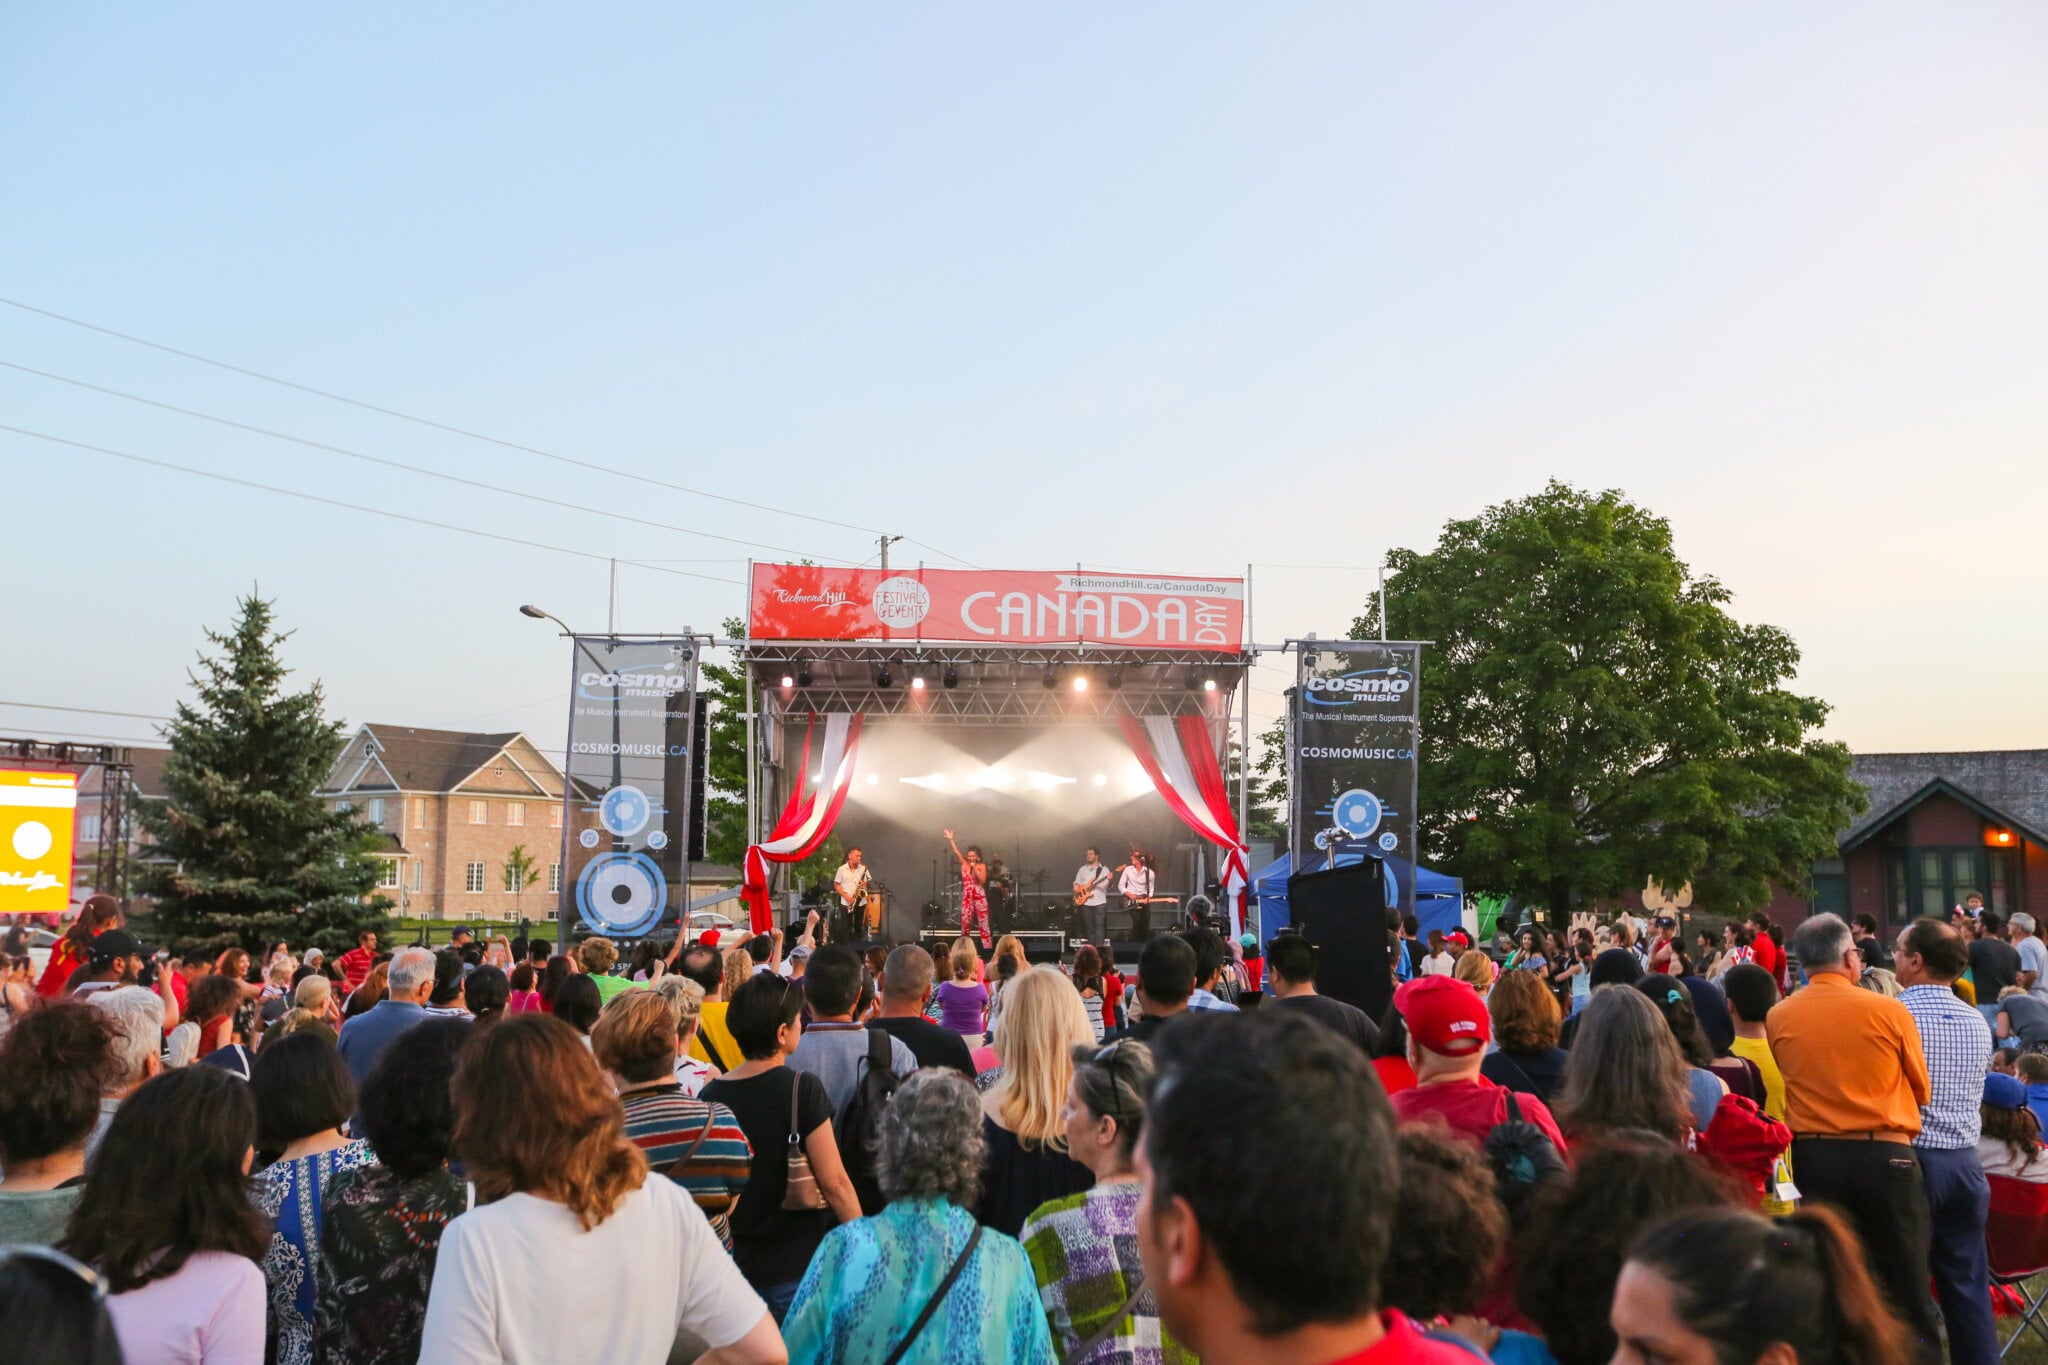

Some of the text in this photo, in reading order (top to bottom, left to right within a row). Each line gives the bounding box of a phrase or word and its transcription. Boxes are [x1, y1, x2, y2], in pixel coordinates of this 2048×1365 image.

[1069, 578, 1227, 594] RichmondHill.ca/CanadaDay
[772, 587, 846, 604] Richmond Hill
[876, 585, 926, 610] FESTIVALS
[960, 591, 1188, 641] CANADA
[1194, 598, 1227, 645] DAY
[580, 672, 685, 689] cosmo
[1306, 677, 1410, 693] cosmo
[625, 688, 675, 698] music
[1352, 692, 1401, 702] music
[614, 708, 650, 718] Instrument
[1301, 711, 1315, 720] The
[1315, 712, 1342, 721] Musical
[1343, 713, 1378, 722] Instrument
[571, 742, 688, 756] COSMOMUSIC.CA
[1300, 747, 1415, 760] COSMOMUSIC.CA
